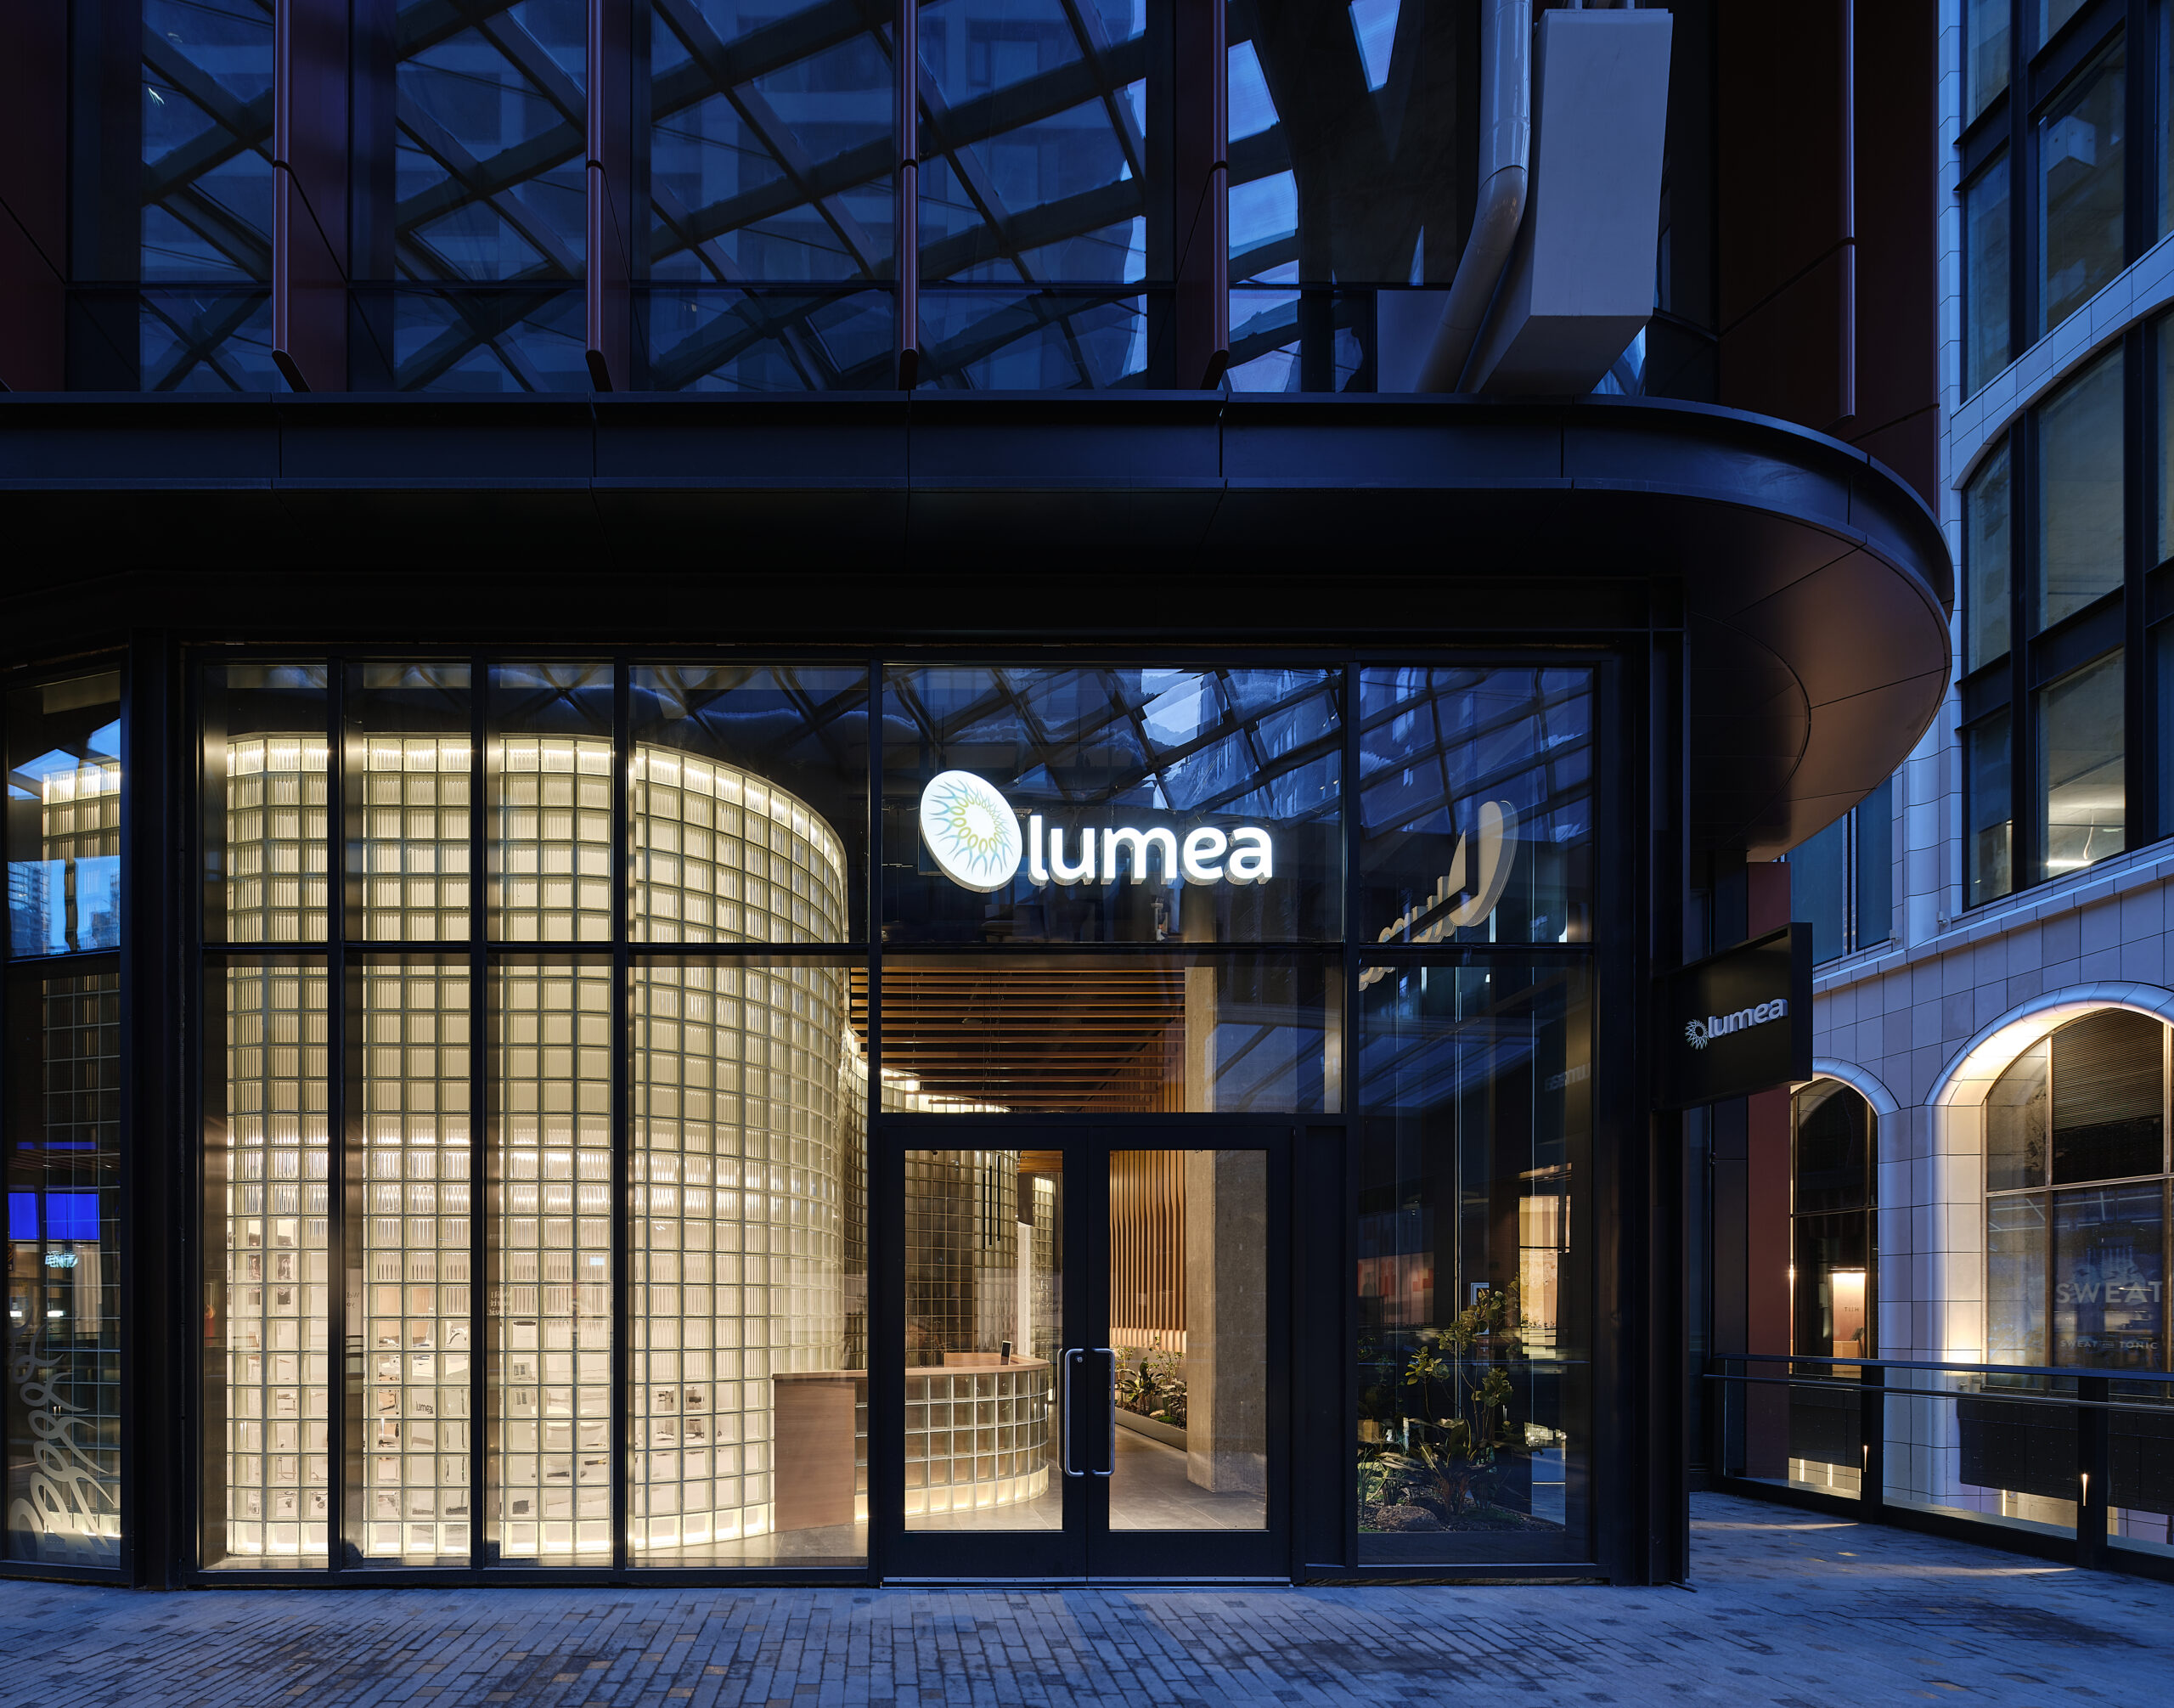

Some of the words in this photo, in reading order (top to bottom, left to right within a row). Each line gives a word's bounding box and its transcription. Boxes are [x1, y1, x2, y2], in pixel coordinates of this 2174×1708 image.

[1028, 815, 1273, 885] lumea
[1708, 998, 1788, 1039] lumea
[2056, 1281, 2163, 1304] SWEAT
[2059, 1339, 2097, 1349] SWEAT
[2120, 1340, 2158, 1350] TONIC
